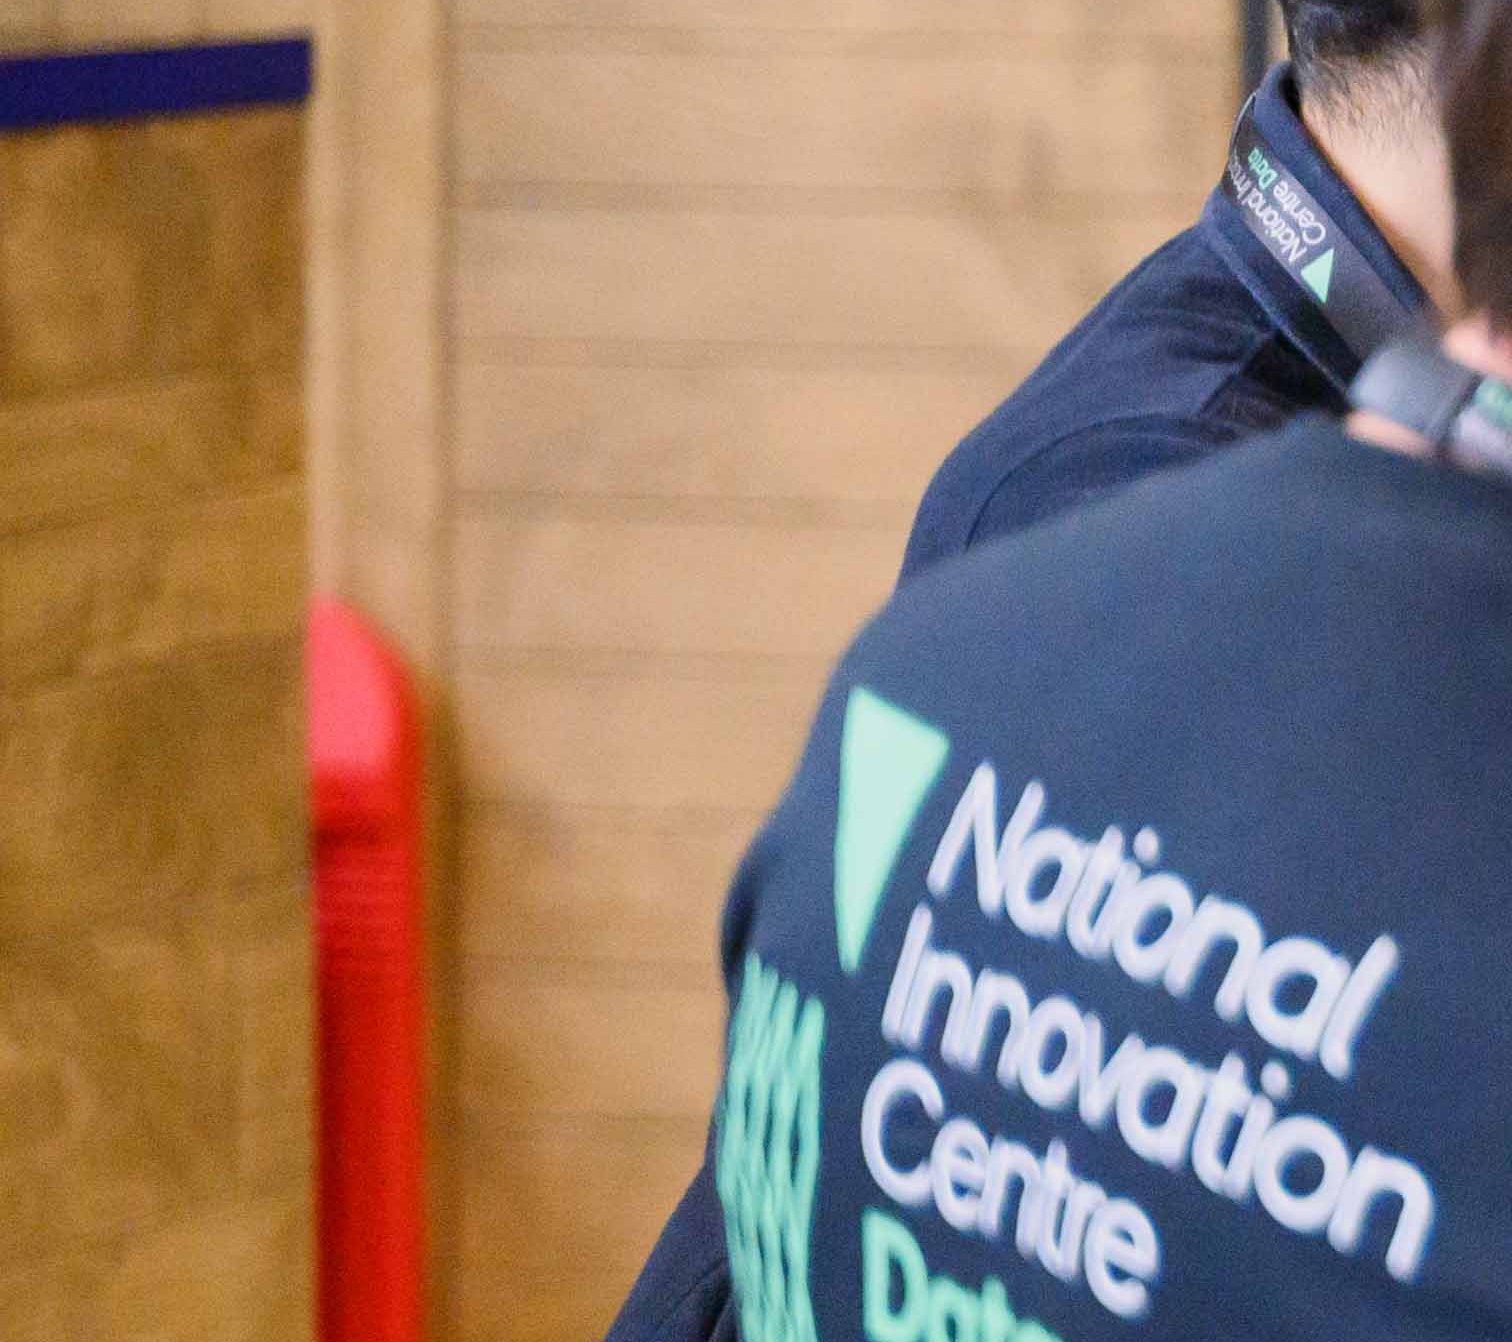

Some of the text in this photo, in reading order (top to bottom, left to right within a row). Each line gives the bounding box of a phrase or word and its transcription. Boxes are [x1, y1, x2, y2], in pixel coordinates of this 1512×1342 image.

[1242, 187, 1307, 264] National
[1248, 147, 1326, 245] Centre Data
[925, 758, 1400, 1082] National
[859, 1057, 1161, 1321] Centre
[879, 902, 1435, 1283] Innovation
